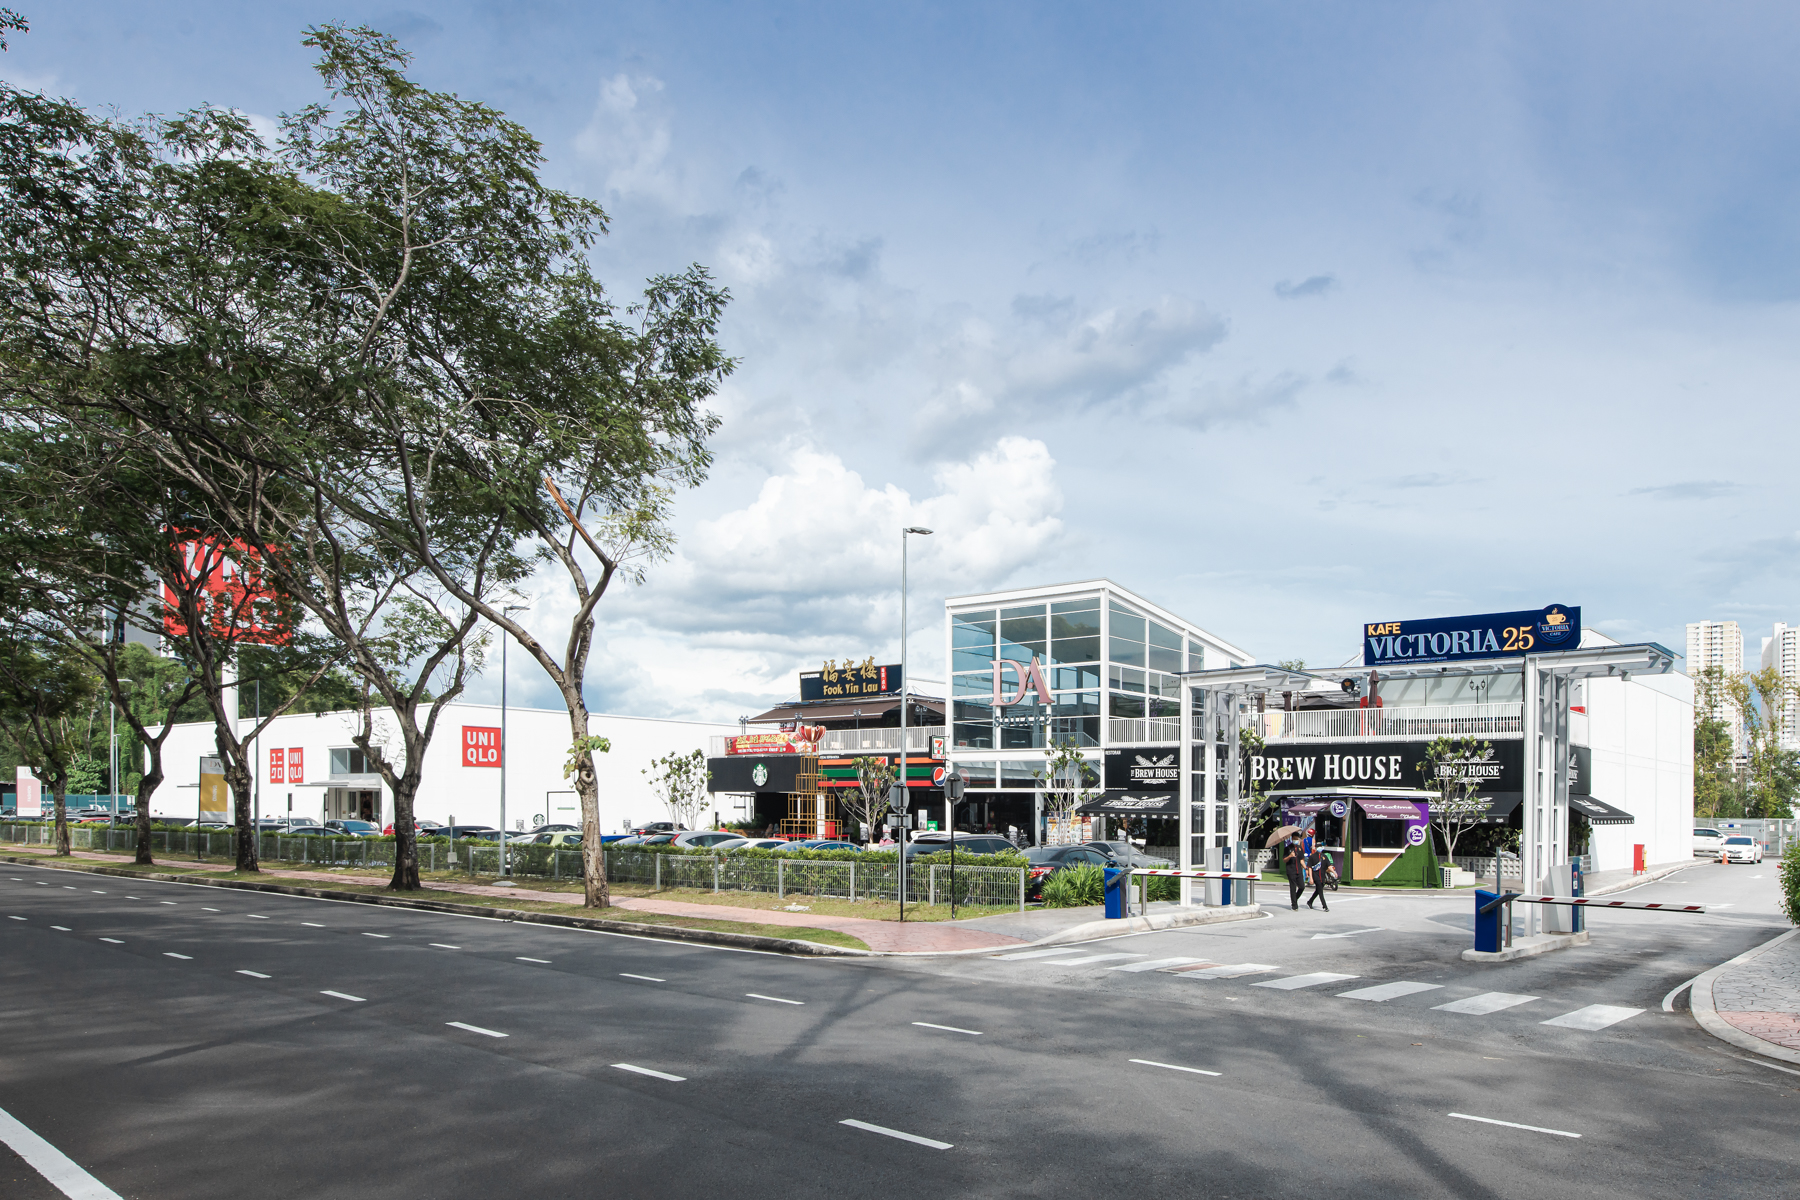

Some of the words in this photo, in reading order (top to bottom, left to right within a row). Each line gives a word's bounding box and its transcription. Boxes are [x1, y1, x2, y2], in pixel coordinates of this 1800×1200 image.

[1367, 622, 1402, 636] KAFE
[1541, 624, 1570, 632] VICTORIA
[1368, 628, 1502, 659] VICTORIA
[1502, 626, 1535, 651] 25
[989, 655, 1055, 706] DA
[823, 684, 844, 696] Fook
[845, 683, 860, 694] Yin
[862, 682, 878, 693] Lau
[994, 713, 1052, 728] SQUARE
[466, 731, 495, 746] UNI
[271, 752, 283, 765] ユニ
[289, 752, 302, 764] UNI
[466, 747, 498, 764] QLO
[271, 767, 283, 779] クロ
[289, 766, 303, 781] QLO
[1134, 768, 1155, 778] BREW
[1155, 768, 1178, 778] HOUSE
[1250, 755, 1317, 781] BREW
[1323, 754, 1402, 781] HOUSE
[1468, 764, 1500, 776] HOUSE
